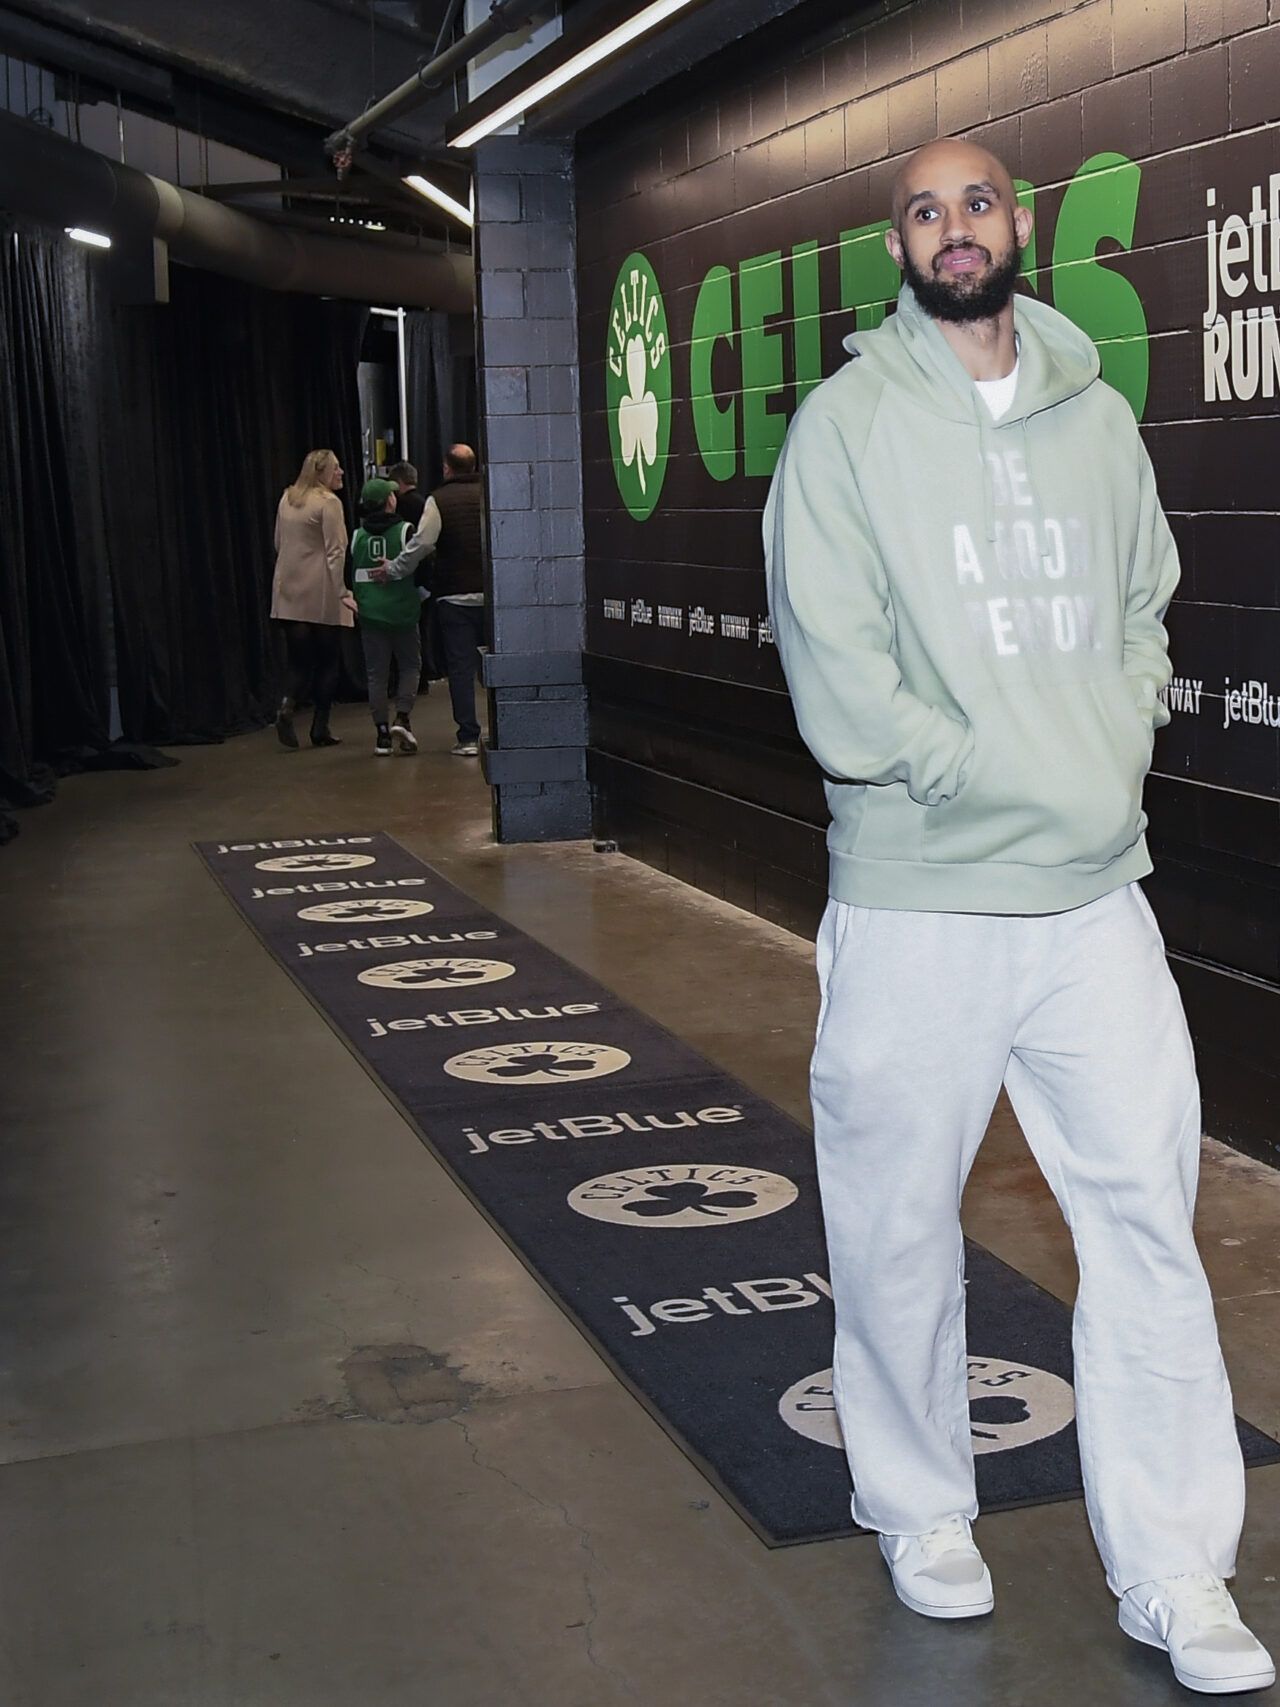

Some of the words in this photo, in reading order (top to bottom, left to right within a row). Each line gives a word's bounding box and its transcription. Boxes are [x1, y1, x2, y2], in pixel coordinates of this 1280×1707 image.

[609, 269, 666, 378] CELTICS
[691, 152, 1149, 481] CELS
[953, 523, 985, 585] A
[217, 837, 373, 854] jetBlue
[251, 878, 426, 899] jetBlue
[299, 930, 498, 957] jetBlue
[366, 1002, 600, 1037] jetBlue
[455, 1045, 610, 1067] CELTICS
[462, 1107, 745, 1154] jetBlue
[581, 1168, 768, 1201] CELTICS
[613, 1273, 835, 1337] jetBl
